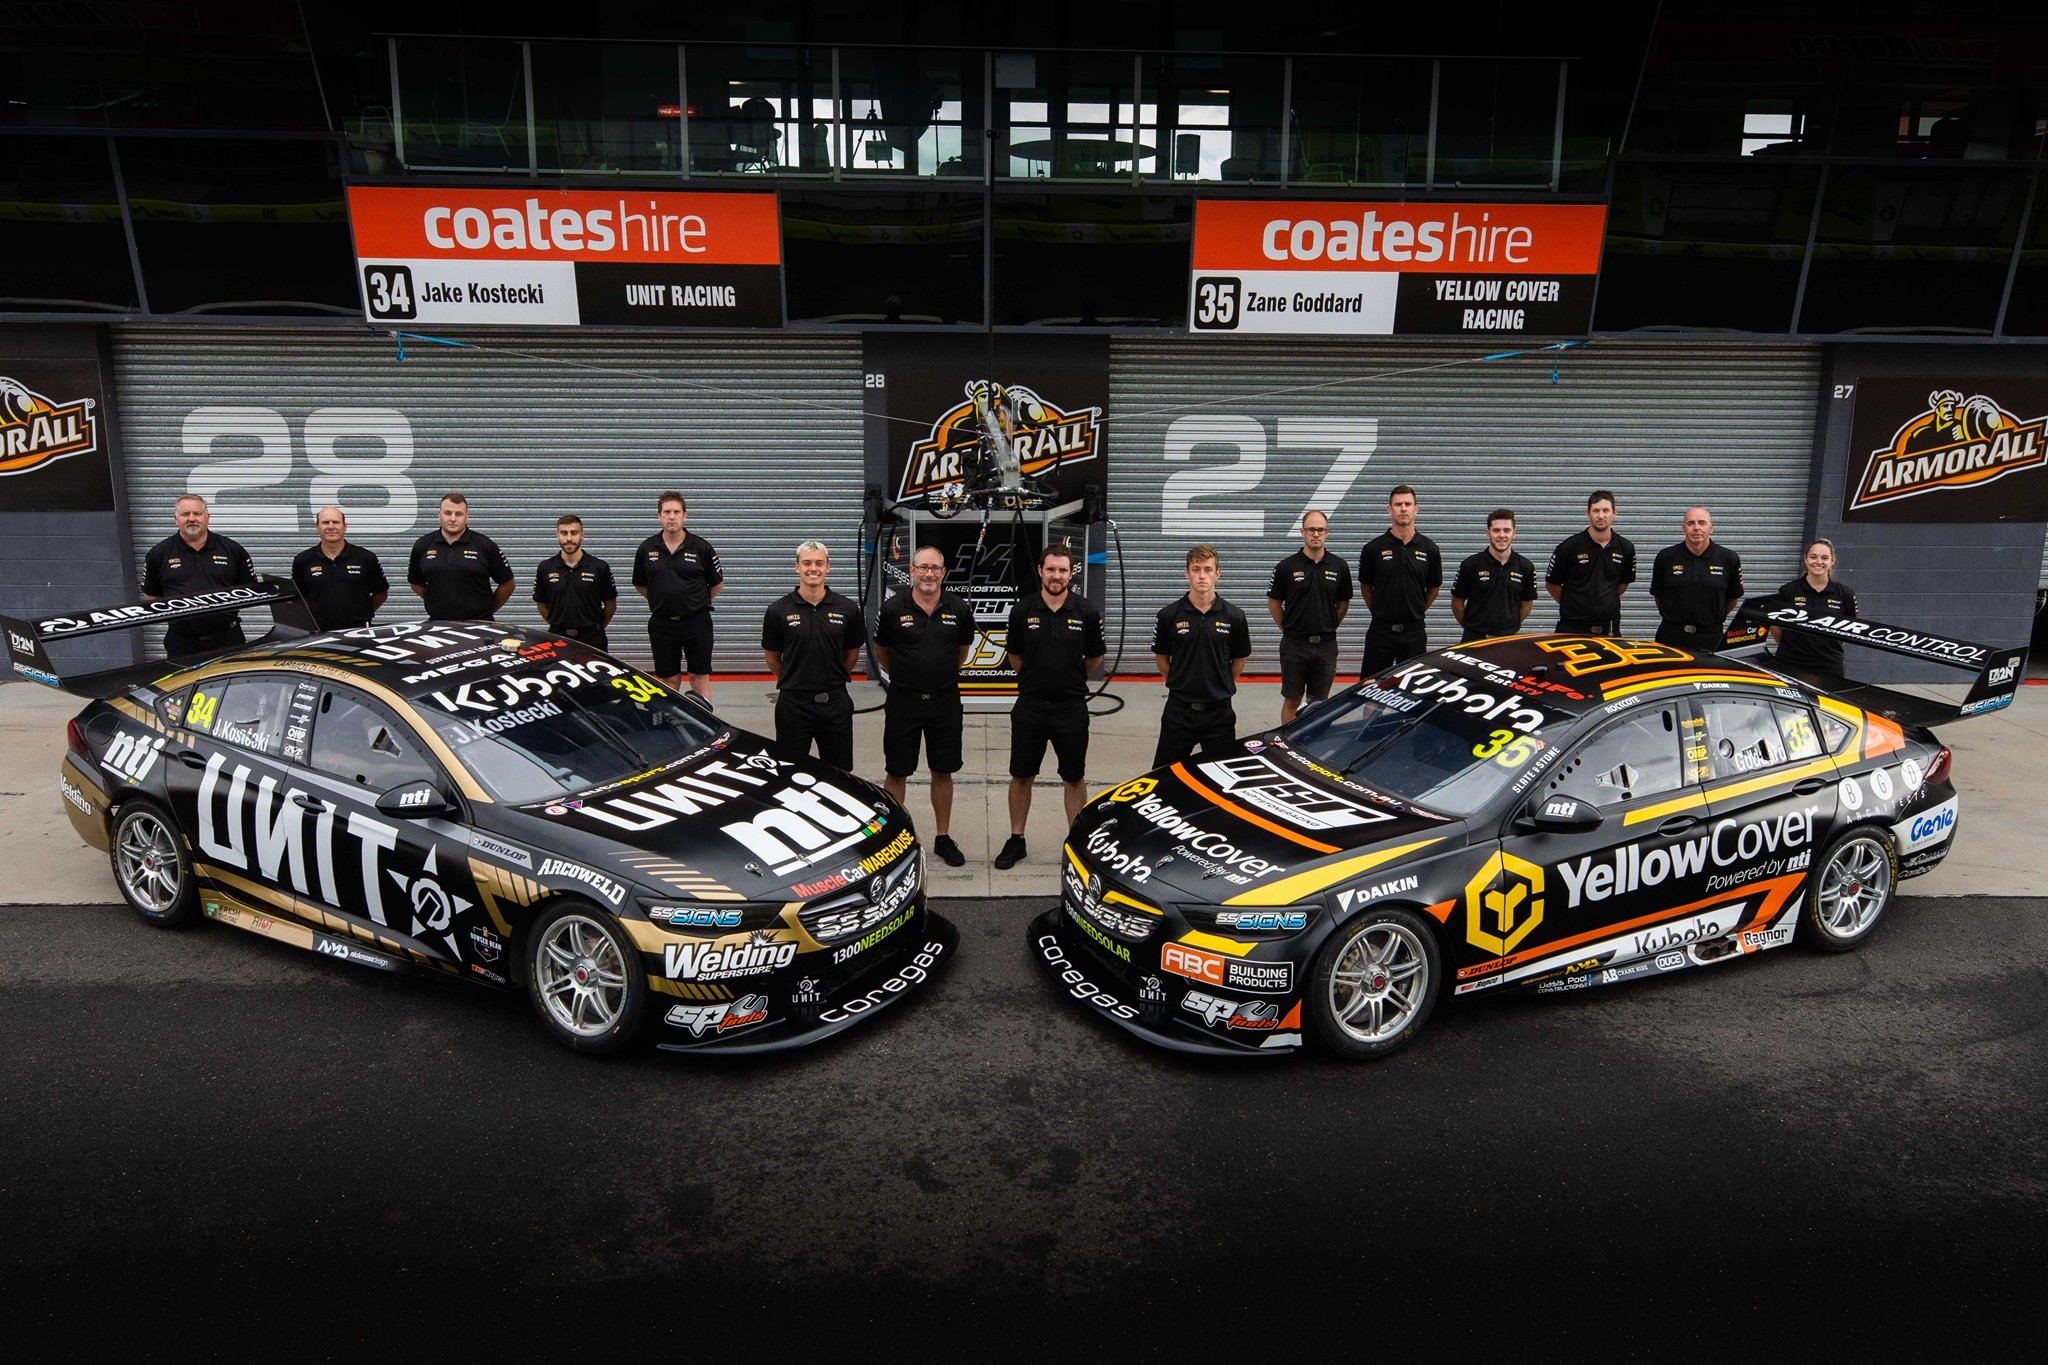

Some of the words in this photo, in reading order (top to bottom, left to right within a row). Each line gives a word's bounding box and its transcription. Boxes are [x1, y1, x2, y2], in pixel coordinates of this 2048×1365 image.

[370, 271, 410, 313] 34
[422, 282, 463, 304] Jake
[468, 282, 544, 304] Kostecki
[626, 284, 666, 306] UNIT
[675, 285, 736, 307] RACING
[1199, 283, 1235, 324] 35
[1246, 293, 1287, 312] Zane
[1293, 293, 1362, 313] Goddard
[1434, 280, 1502, 301] YELLOW
[1505, 281, 1560, 302] COVER
[1462, 309, 1524, 330] RACING
[865, 374, 885, 388] 28
[1833, 385, 1854, 399] 27
[181, 406, 418, 533] 28
[1161, 414, 1378, 537] 27
[943, 543, 1016, 583] 34
[90, 606, 153, 623] AIR
[150, 587, 267, 612] CONTROL
[1726, 633, 1757, 645] WAREHOUSE
[1727, 629, 1747, 637] Muscle
[1747, 627, 1757, 635] Car
[1808, 615, 1870, 633] AIR
[1868, 628, 1987, 661] CONTROL
[273, 660, 353, 680] EARMOLD.COM.AU
[425, 648, 476, 665] SUPPORTING
[499, 650, 556, 668] Battery
[1535, 636, 1694, 677] 35
[431, 659, 629, 712] Kubota
[611, 675, 668, 703] 34
[1357, 683, 1422, 712] Goddard
[1394, 662, 1545, 734] Kubota
[1483, 674, 1543, 695] Battery
[187, 692, 217, 729] 34
[456, 699, 563, 745] J.Kostecki
[1472, 729, 1538, 768] 35
[1784, 716, 1816, 753] 35
[103, 730, 166, 782] nti
[1687, 747, 1707, 760] OMP
[577, 746, 711, 797] autosport.com.au
[1286, 750, 1403, 806] autosport.com.au
[1512, 770, 1536, 793] SLATE
[1535, 746, 1561, 769] STONE
[400, 788, 431, 807] nti
[1545, 802, 1577, 817] nti
[1846, 789, 1926, 825] ARCHITECTS
[720, 772, 877, 866] nti
[1910, 807, 1954, 842] Genie
[1131, 792, 1286, 880] YellowCover
[481, 840, 527, 861] DUNLOP
[1087, 828, 1152, 884] Kubota
[1171, 844, 1219, 869] Powered
[1557, 805, 1819, 908] YellowCover
[1705, 864, 1766, 893] Powered
[1766, 858, 1788, 878] by
[1786, 849, 1812, 871] nti
[1357, 875, 1418, 903] DAIKIN
[218, 913, 237, 924] DIGITAL
[220, 905, 240, 916] FRESH
[1743, 928, 1788, 946] Raynor
[664, 942, 798, 979] Welding
[697, 965, 773, 981] SUPERSTORE
[1165, 948, 1221, 980] ABC
[1229, 964, 1288, 979] BUILDING
[1468, 956, 1518, 975] DUNLOP
[1602, 968, 1618, 983] AB
[1617, 967, 1635, 976] CRANE
[1635, 964, 1648, 974] HIRE
[1659, 956, 1682, 967] DUCE
[819, 941, 943, 1023] coregas
[1038, 935, 1140, 1019] coregas
[1228, 975, 1288, 988] PRODUCTS
[1567, 974, 1587, 984] Pool
[718, 1011, 767, 1032] tools
